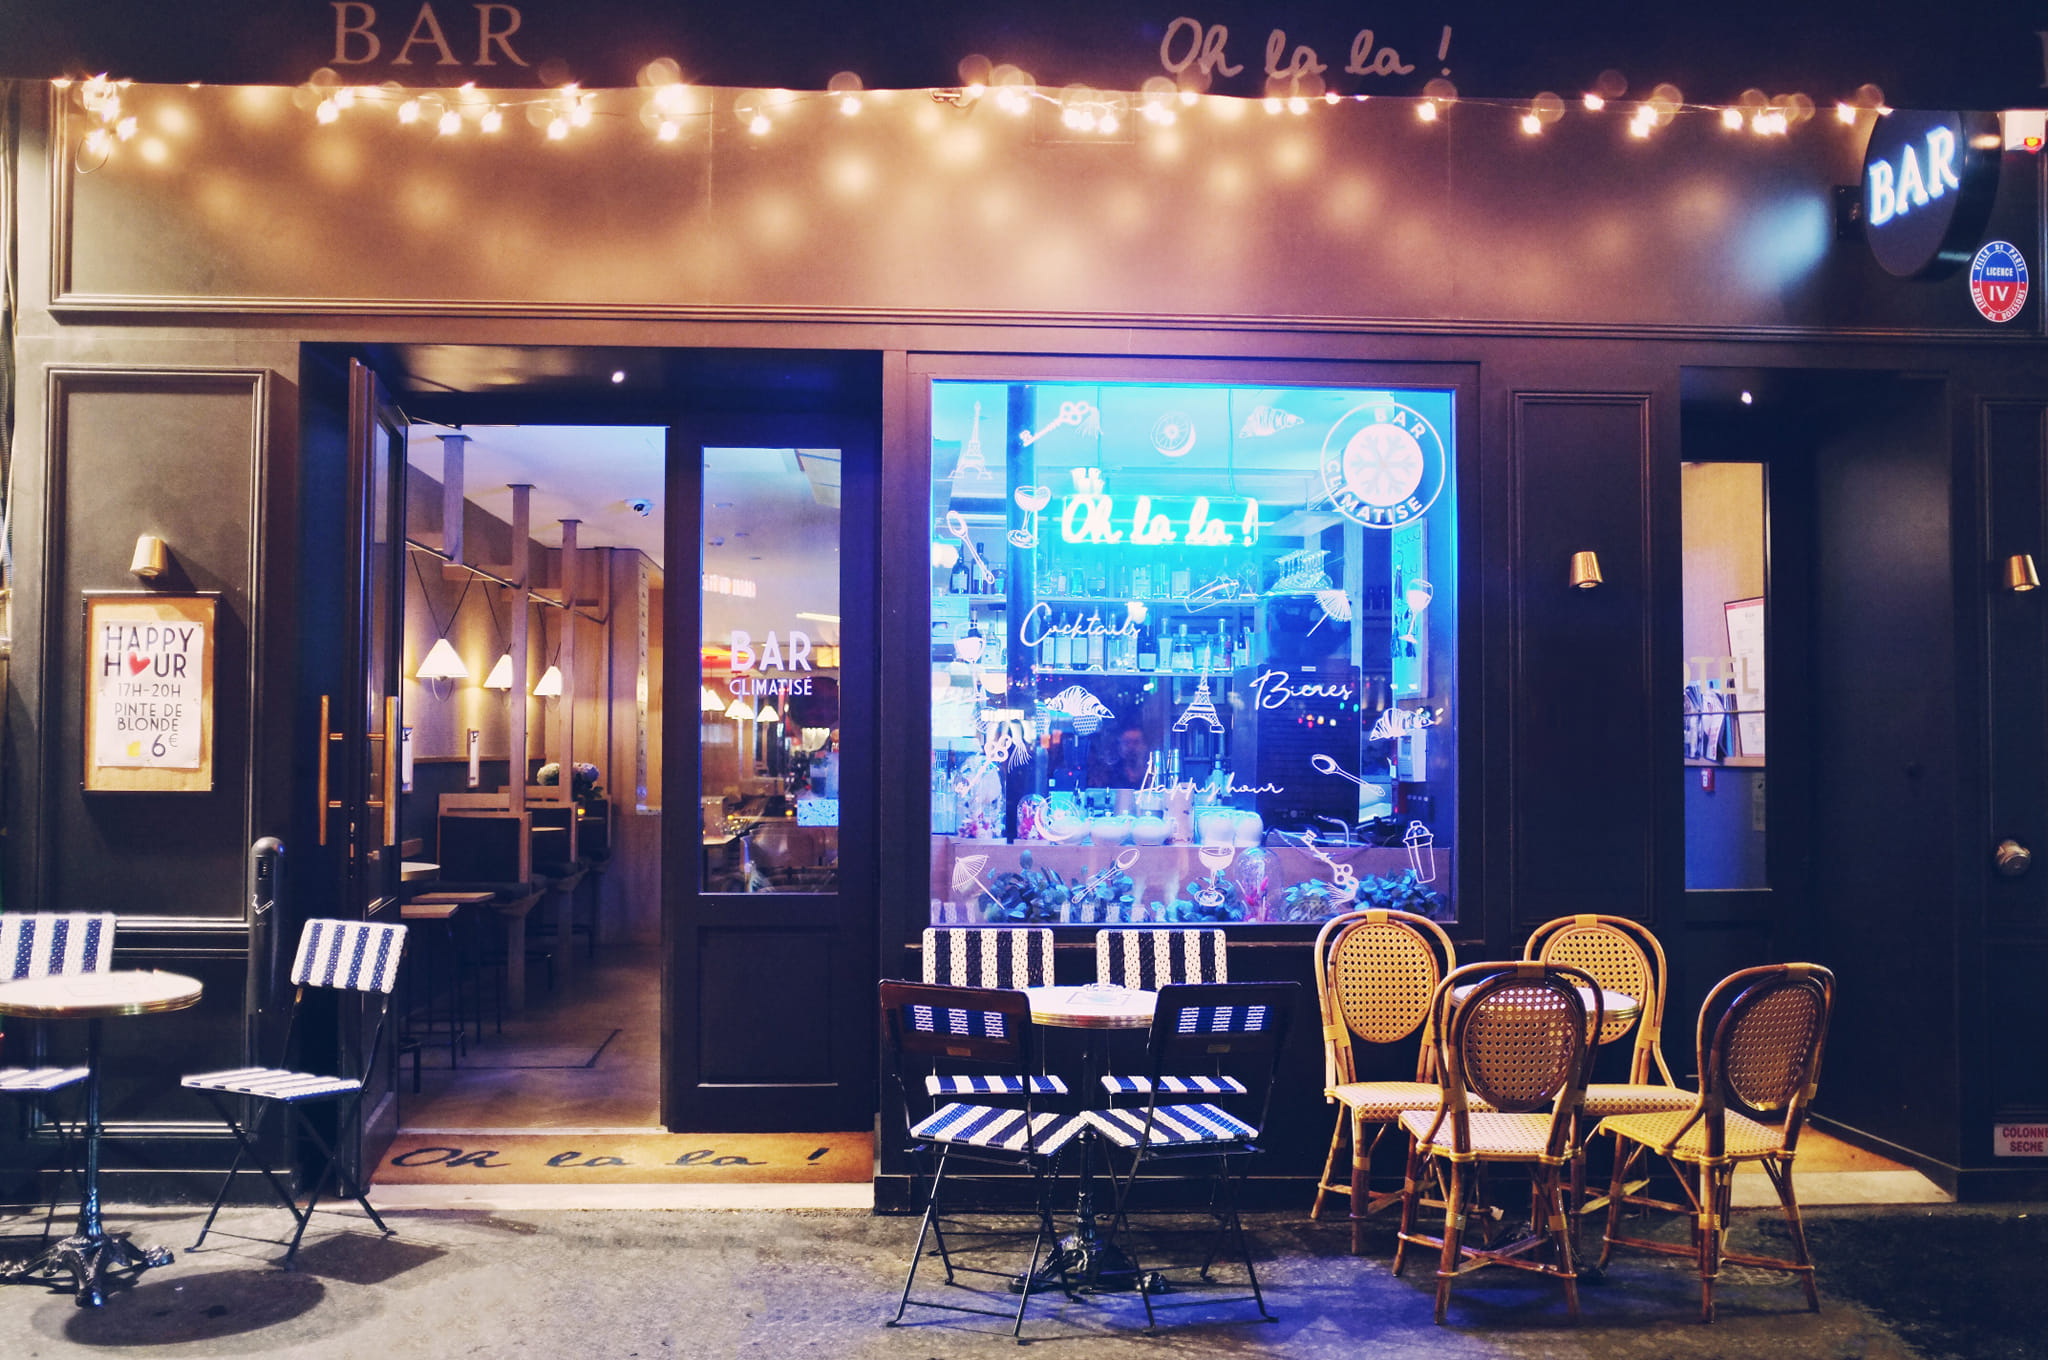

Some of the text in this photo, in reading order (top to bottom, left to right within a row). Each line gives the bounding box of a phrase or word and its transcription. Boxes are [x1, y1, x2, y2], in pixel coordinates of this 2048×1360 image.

[329, 1, 530, 67] BAR
[1160, 16, 1243, 77] Oh
[1264, 28, 1328, 79] la
[1345, 29, 1415, 76] la
[1868, 125, 1960, 226] BAR
[1974, 248, 1990, 270] VILLE
[2008, 248, 2025, 272] PARIS
[1986, 266, 2014, 277] LICENCE
[1989, 285, 2009, 302] IV
[1374, 407, 1426, 439] BAR
[1061, 495, 1123, 544] Oh
[1130, 495, 1177, 545] la
[1184, 496, 1233, 545] la
[105, 625, 194, 652] HAPPY
[1020, 601, 1142, 647] Cocktails
[731, 630, 812, 671] BAR
[729, 676, 813, 696] CLIMATISÉ
[1684, 655, 1760, 695] TEL
[115, 702, 182, 718] PINTE DE
[117, 717, 179, 732] BLONDE
[1134, 751, 1285, 804] Happy hour
[391, 1147, 511, 1168] Oh
[544, 1151, 636, 1167] la
[665, 1150, 767, 1166] la
